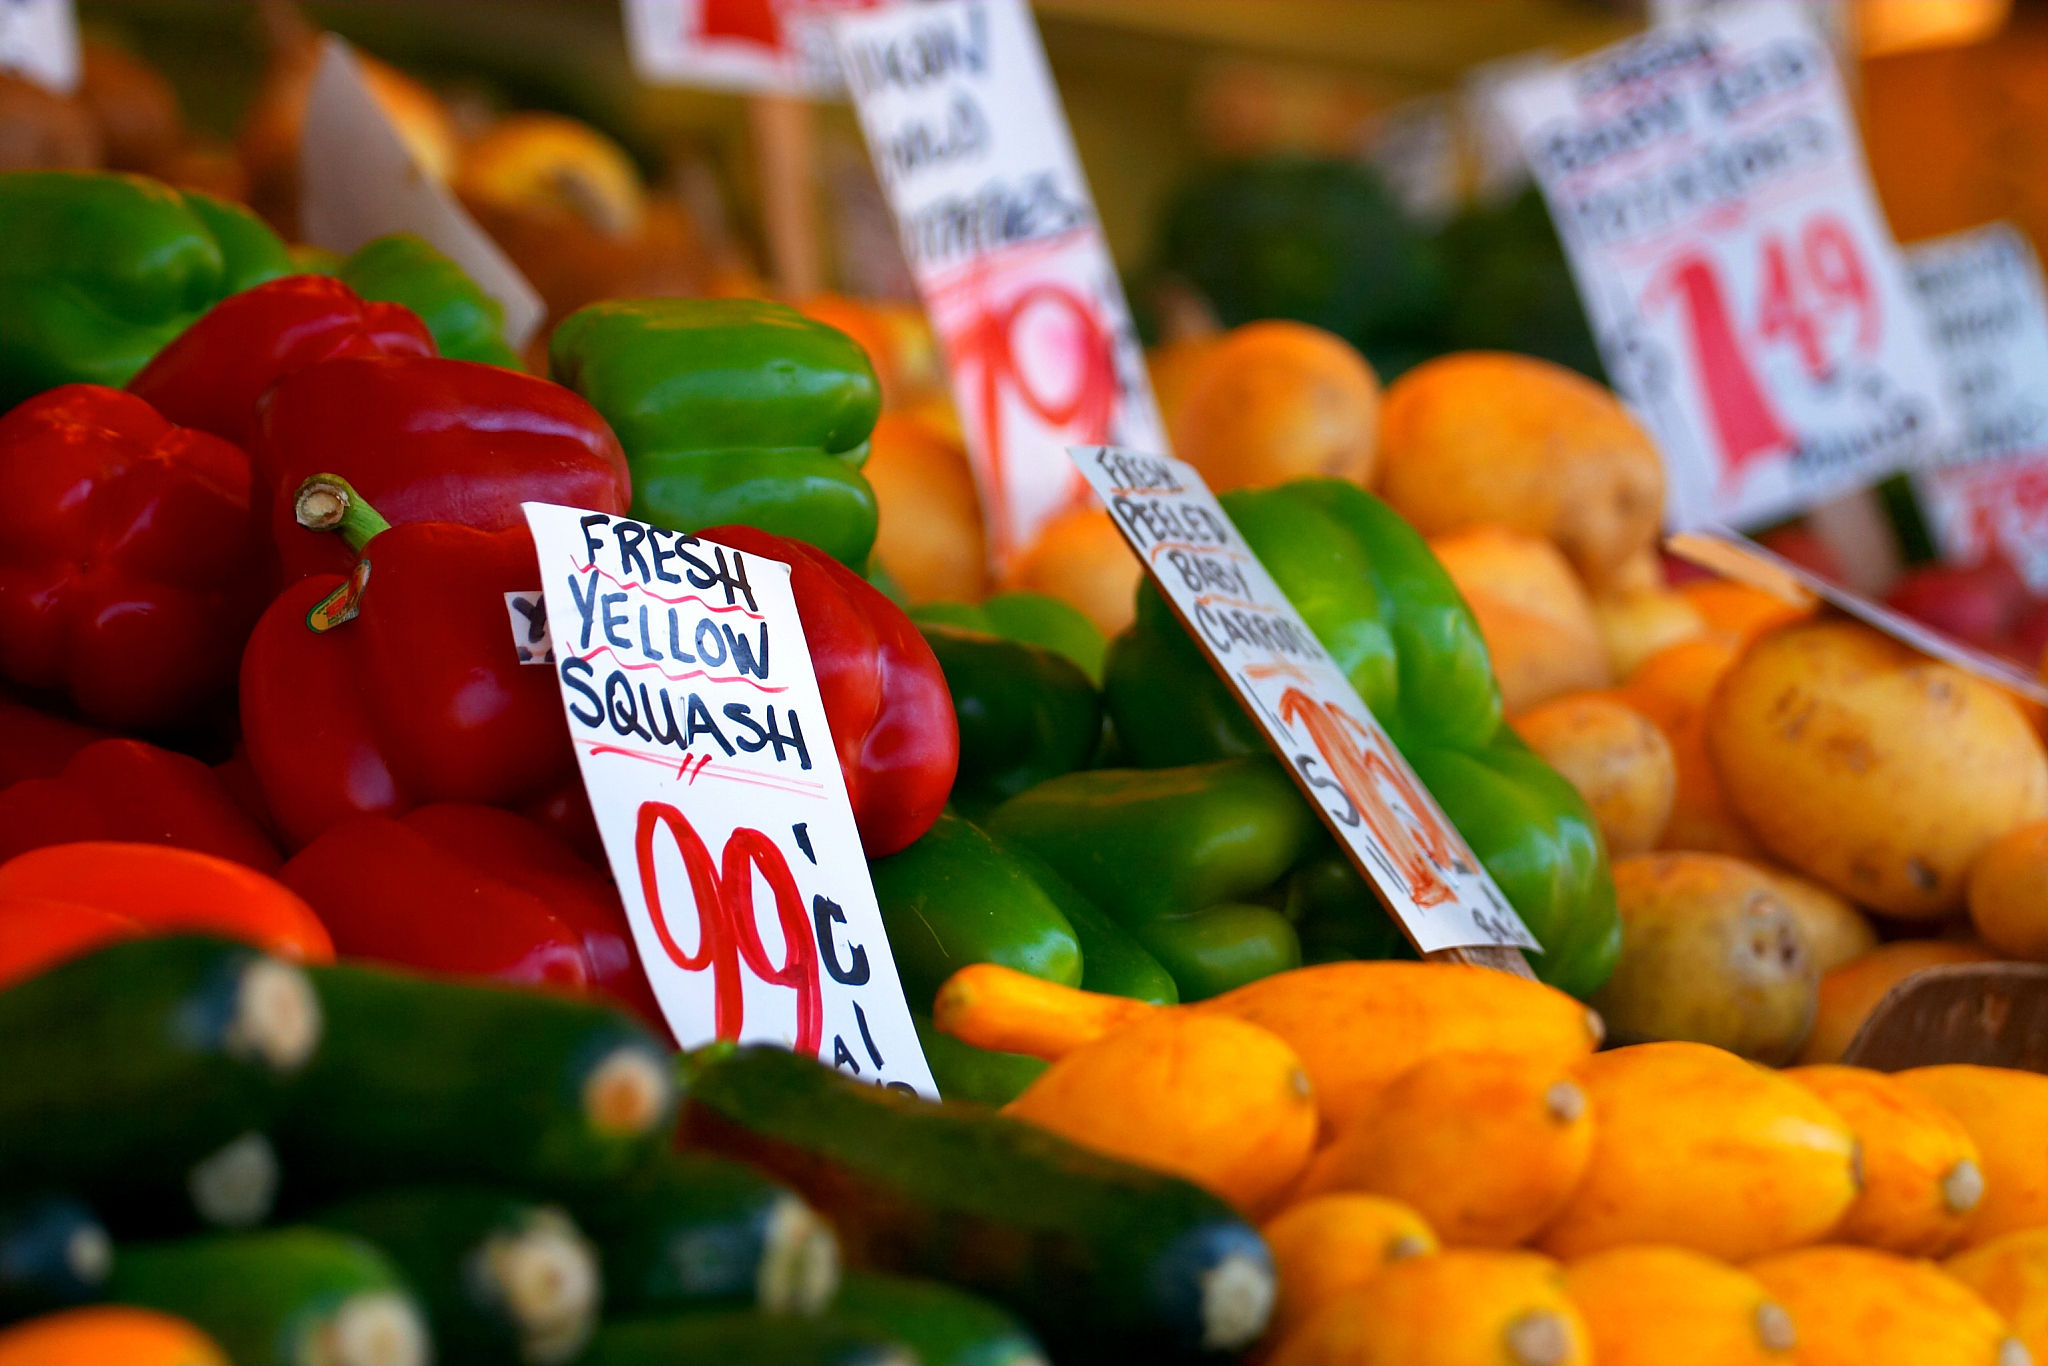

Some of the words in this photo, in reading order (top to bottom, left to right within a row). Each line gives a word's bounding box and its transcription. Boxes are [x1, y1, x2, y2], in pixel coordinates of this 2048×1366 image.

[1096, 447, 1182, 490] FRESH
[1113, 495, 1227, 549] PEELED
[580, 515, 757, 612] FRESH
[1167, 549, 1254, 601] BABY
[568, 570, 769, 679] YELLOW
[561, 657, 812, 770] SQUASH
